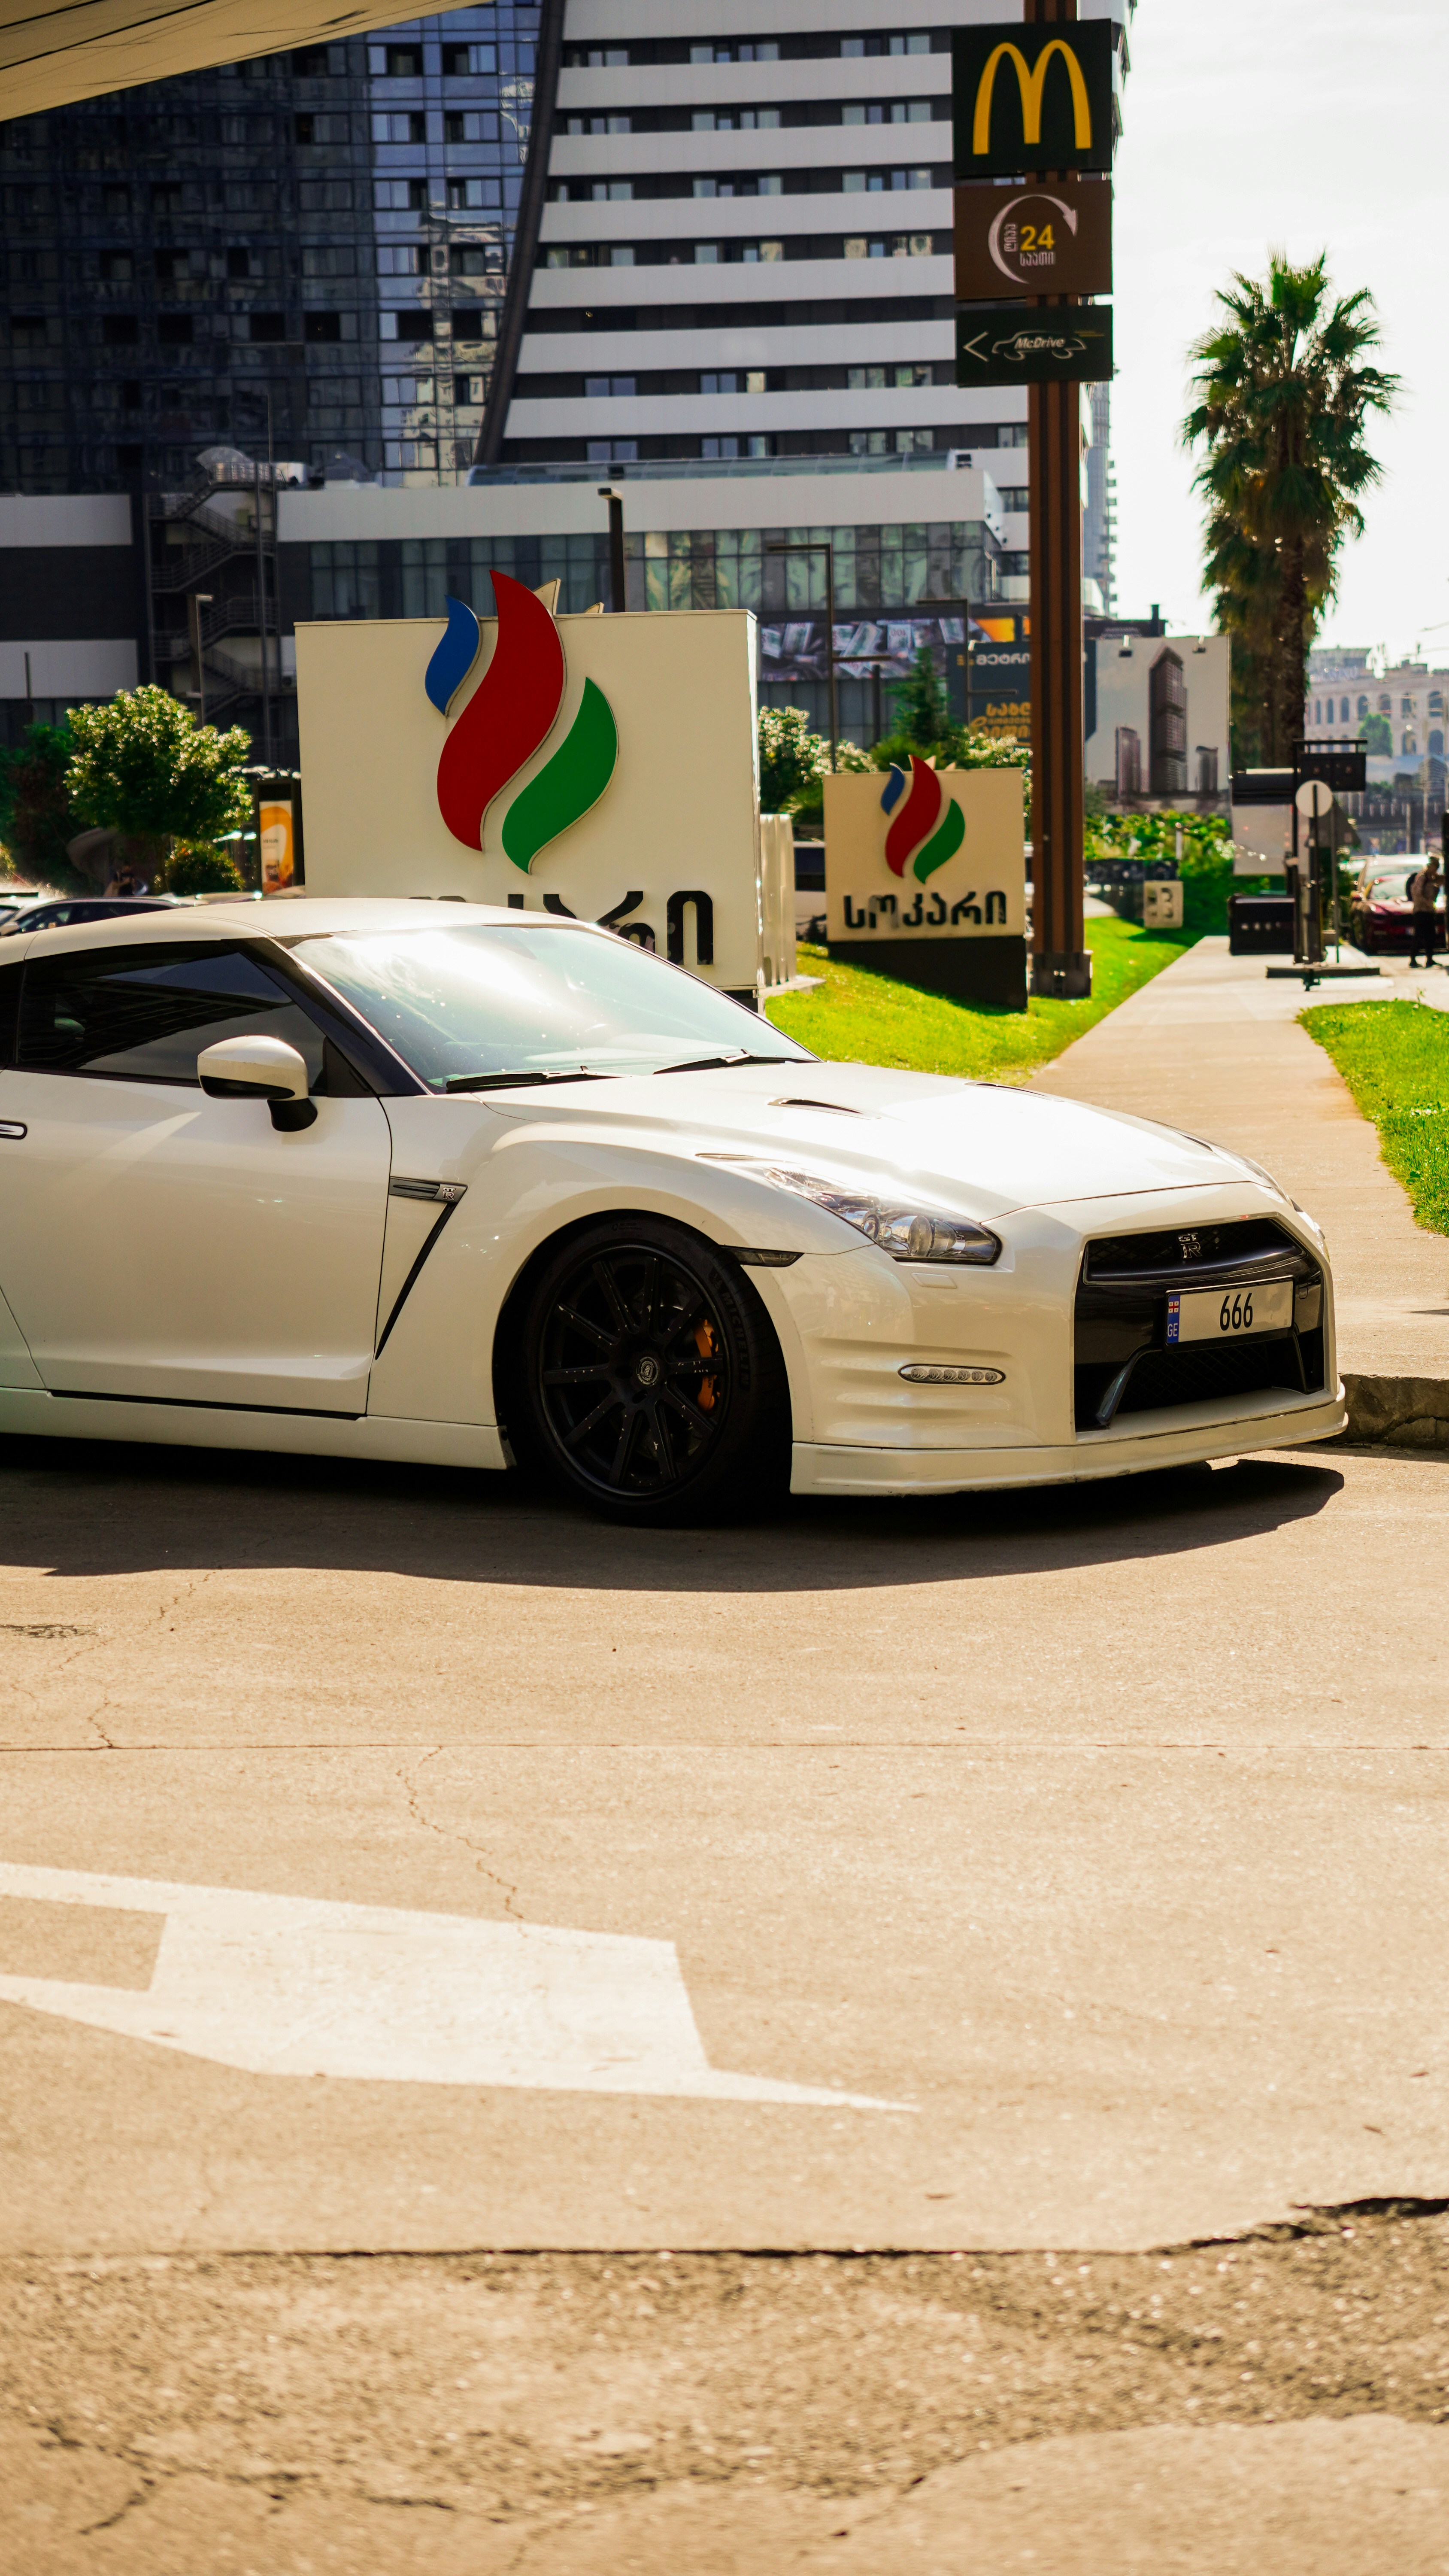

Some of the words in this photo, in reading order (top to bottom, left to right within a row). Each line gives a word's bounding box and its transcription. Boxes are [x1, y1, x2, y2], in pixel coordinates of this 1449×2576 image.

[1020, 225, 1055, 251] 24
[1020, 252, 1055, 267] საათი
[1014, 337, 1066, 349] McDrive
[844, 890, 1006, 929] სოკარი
[443, 1191, 455, 1200] R
[1180, 1242, 1202, 1258] R
[1219, 1293, 1253, 1331] 666
[1167, 1323, 1178, 1337] GE
